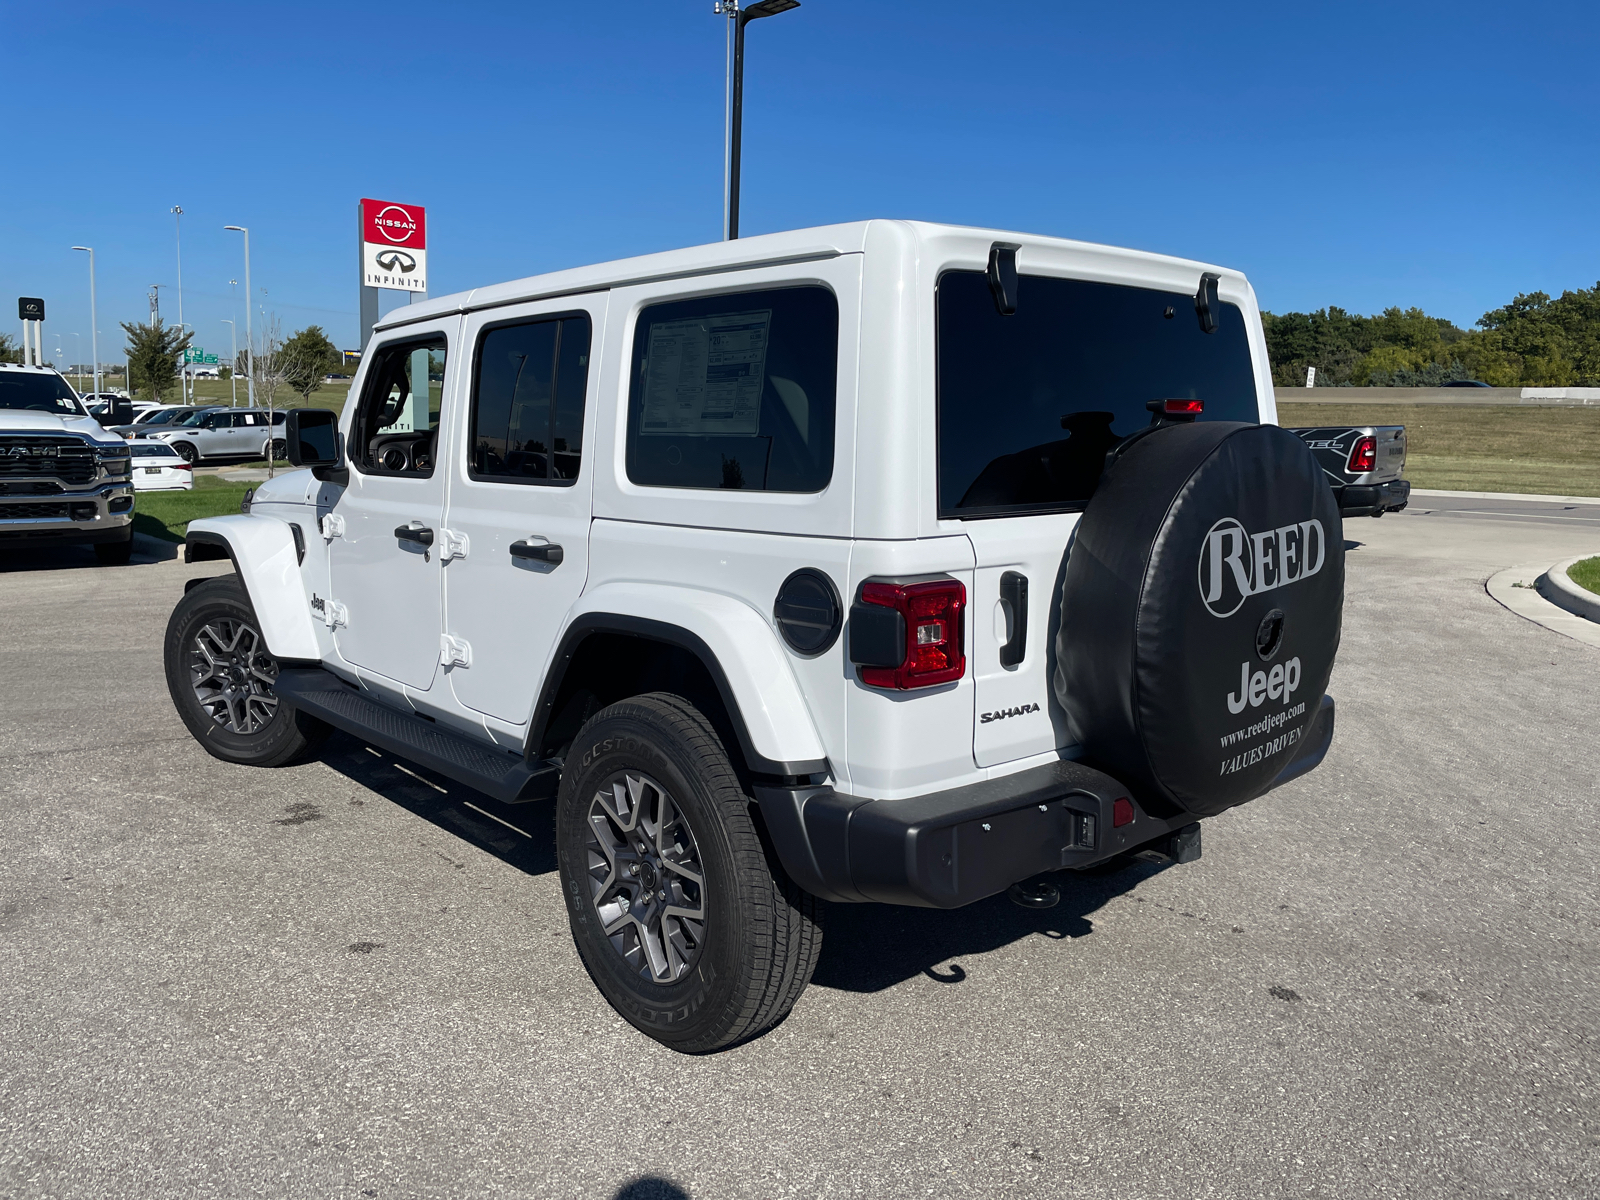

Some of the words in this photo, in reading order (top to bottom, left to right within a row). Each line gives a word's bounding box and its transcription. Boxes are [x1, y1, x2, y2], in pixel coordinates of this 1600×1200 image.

[375, 218, 416, 230] NISSAN
[367, 274, 425, 288] INFINITI
[1206, 518, 1326, 604] REED
[1227, 656, 1301, 714] Jeep
[980, 702, 1040, 724] SAHARA
[1220, 701, 1306, 748] www.reedjeep.com
[1219, 744, 1264, 777] VALUES
[1263, 725, 1304, 758] DRIVEN
